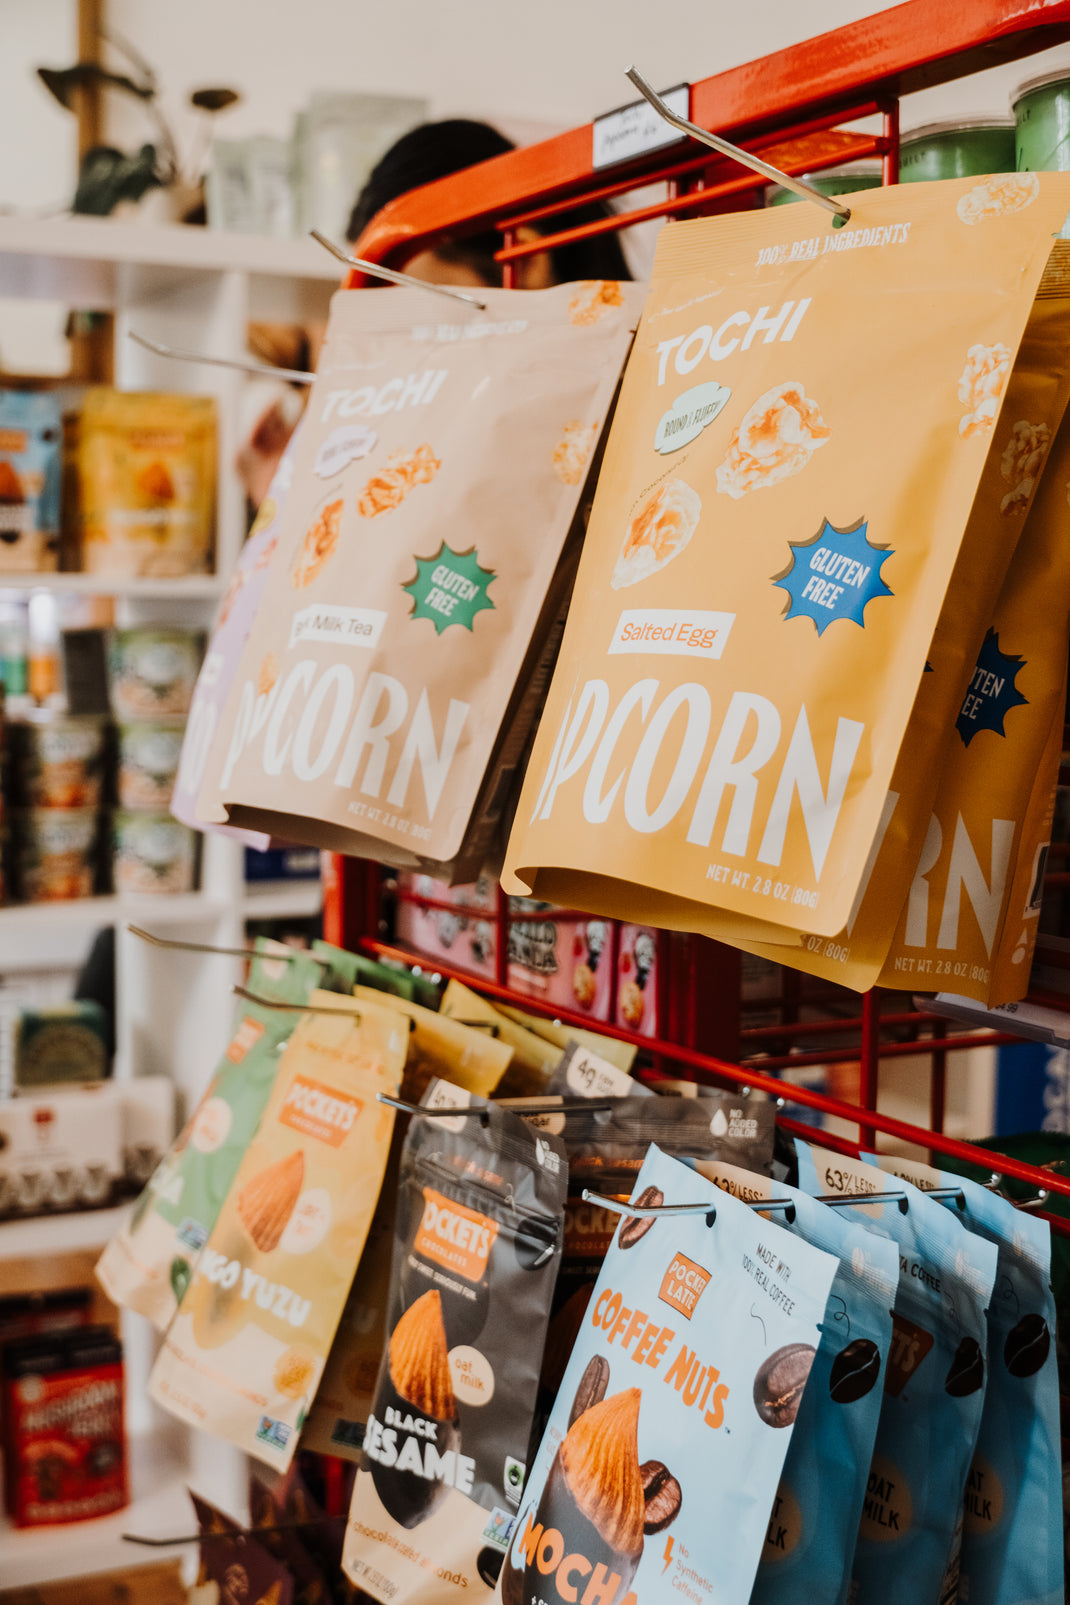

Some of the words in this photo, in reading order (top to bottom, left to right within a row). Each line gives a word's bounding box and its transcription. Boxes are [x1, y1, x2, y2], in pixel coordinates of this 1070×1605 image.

[788, 237, 820, 261] REAL
[820, 222, 912, 255] INGREDIENTS
[656, 297, 812, 386] TOCHI
[321, 369, 448, 424] TOCHI
[664, 414, 688, 438] ROUND
[692, 400, 722, 426] FLUFFY
[431, 565, 480, 602] GLUTEN
[809, 547, 871, 589] GLUTEN
[424, 587, 459, 617] FREE
[801, 575, 845, 610] FREE
[312, 614, 344, 632] Milk
[347, 618, 374, 636] Tea
[620, 621, 677, 641] Salted
[676, 623, 719, 648] Egg
[969, 666, 1005, 699] TEN
[219, 659, 471, 822] PCORN
[530, 671, 865, 884] PCORN
[705, 863, 730, 884] NET
[752, 876, 772, 896] 2.8
[773, 882, 791, 901] OZ
[894, 957, 915, 972] NET
[954, 962, 968, 977] OZ
[729, 1109, 743, 1119] NO
[729, 1119, 758, 1128] ADDED
[728, 1128, 757, 1138] COLOR
[825, 1167, 853, 1195] 63%
[668, 1260, 707, 1294] POCKET
[756, 1242, 777, 1269] MADE
[776, 1260, 792, 1282] WITH
[911, 1263, 941, 1294] COFFEE
[241, 1267, 312, 1327] YUZU
[666, 1280, 696, 1311] LATTE
[754, 1267, 770, 1292] REAL
[769, 1284, 795, 1316] COFFEE
[592, 1288, 676, 1369] COFFEE
[455, 1358, 473, 1373] oat
[460, 1372, 485, 1391] milk
[385, 1406, 438, 1441] BLACK
[867, 1472, 895, 1503] OAT
[679, 1543, 689, 1558] No
[676, 1559, 713, 1594] Synthetic
